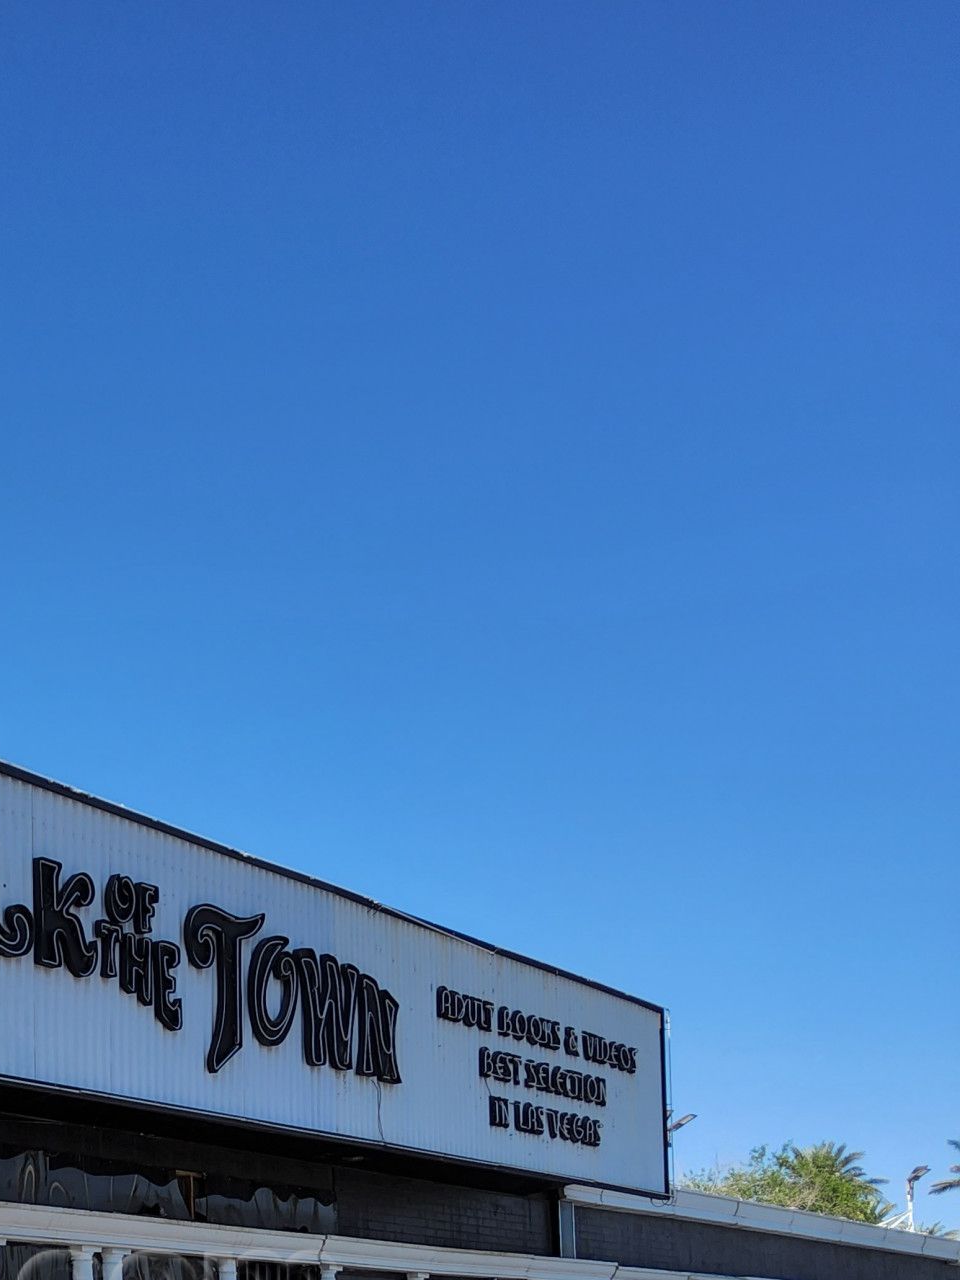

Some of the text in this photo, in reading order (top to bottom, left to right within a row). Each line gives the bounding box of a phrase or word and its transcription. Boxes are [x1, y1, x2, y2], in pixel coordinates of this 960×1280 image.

[104, 872, 159, 934] OF
[95, 921, 183, 1031] THE
[184, 902, 402, 1085] TOWN
[436, 985, 639, 1074] ADULT BOOKS & VIDEOS
[478, 1046, 607, 1106] BEST SELECTION
[489, 1095, 602, 1147] IN LAS VEGAS
